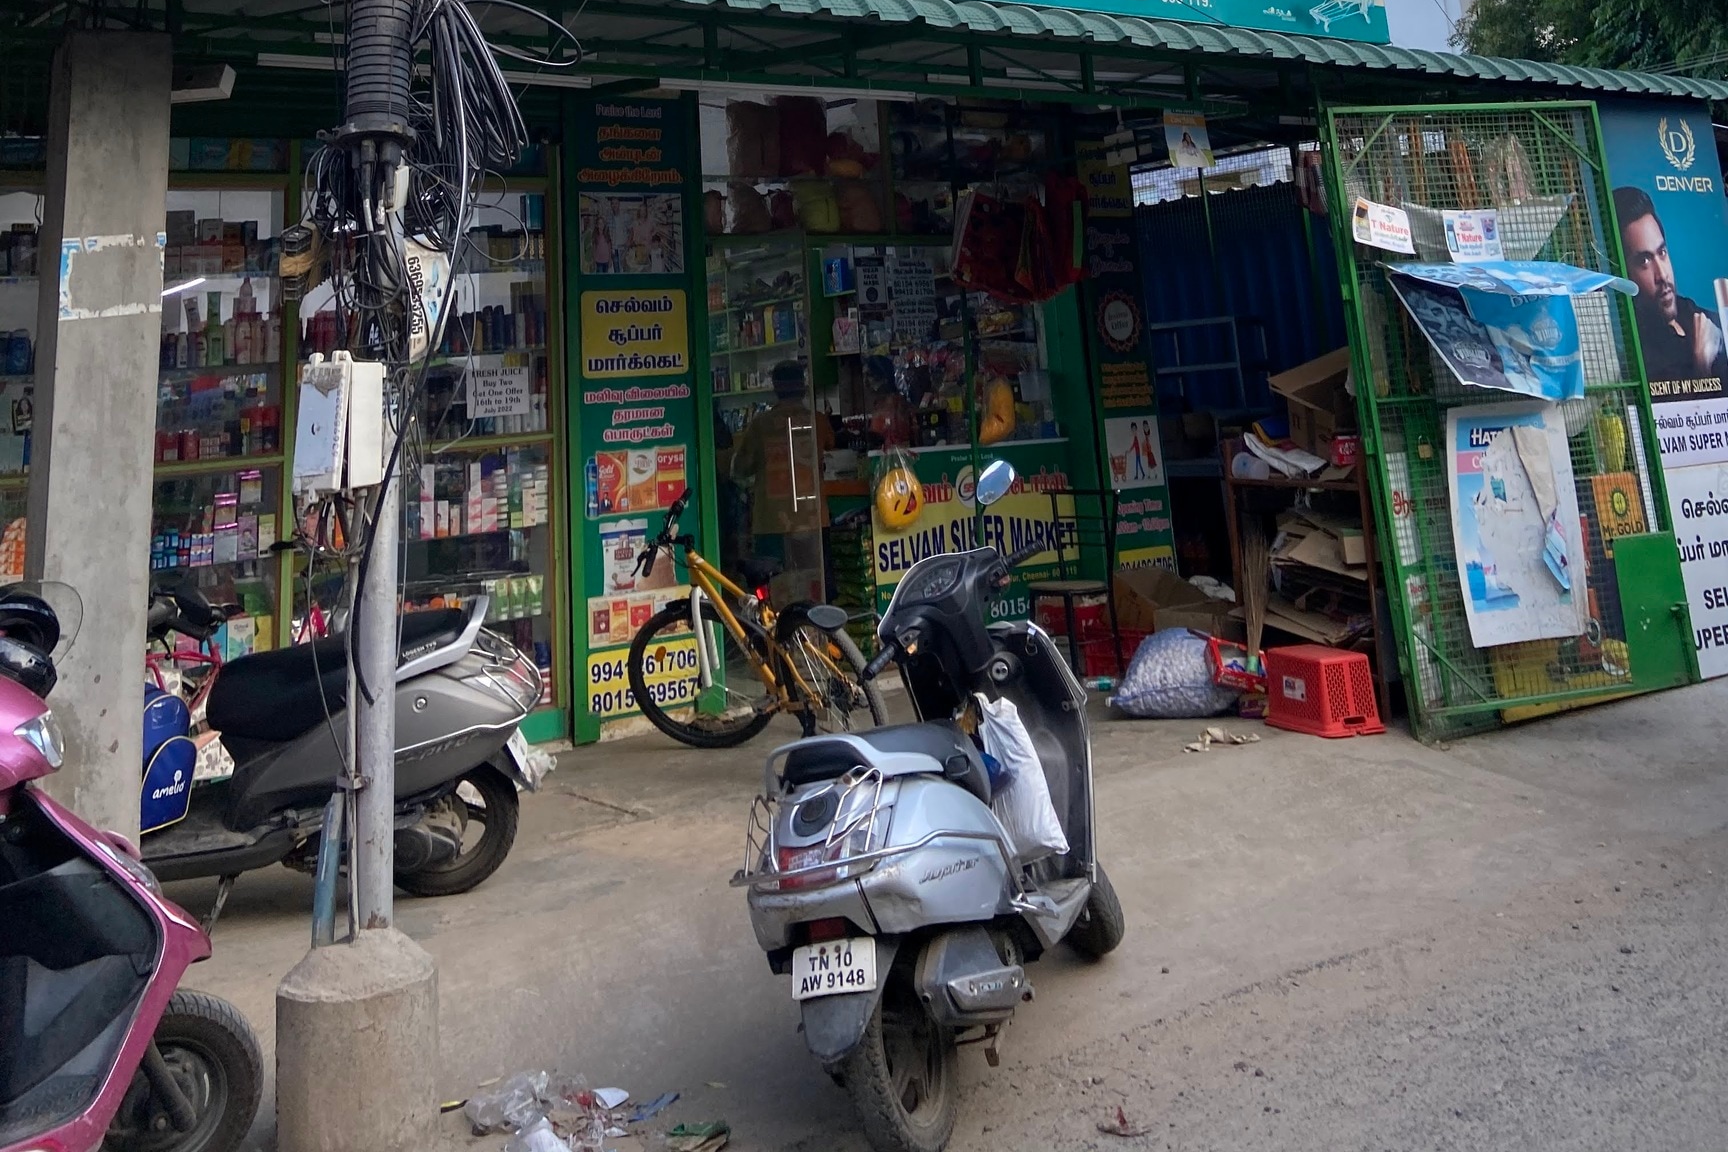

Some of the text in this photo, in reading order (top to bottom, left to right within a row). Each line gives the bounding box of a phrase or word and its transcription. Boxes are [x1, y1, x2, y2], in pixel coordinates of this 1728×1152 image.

[1669, 131, 1687, 153] D
[1655, 175, 1714, 193] DENVER
[1379, 222, 1410, 236] Nature
[1461, 233, 1483, 243] Nature
[596, 295, 673, 315] செல்வம்
[608, 324, 663, 345] சூப்பர்
[501, 368, 523, 376] JUICE
[588, 353, 684, 372] மார்க்கெட்
[1649, 377, 1722, 396] SCENT OF MY SUCCESS
[1658, 436, 1688, 454] LVAM
[1689, 432, 1724, 451] SUPER
[878, 524, 946, 573] SELVAM
[591, 648, 697, 684] 99461706
[592, 676, 699, 712] 801569567
[152, 769, 186, 800] amelio
[809, 951, 852, 971] TN 10
[801, 969, 865, 994] AW 9148
